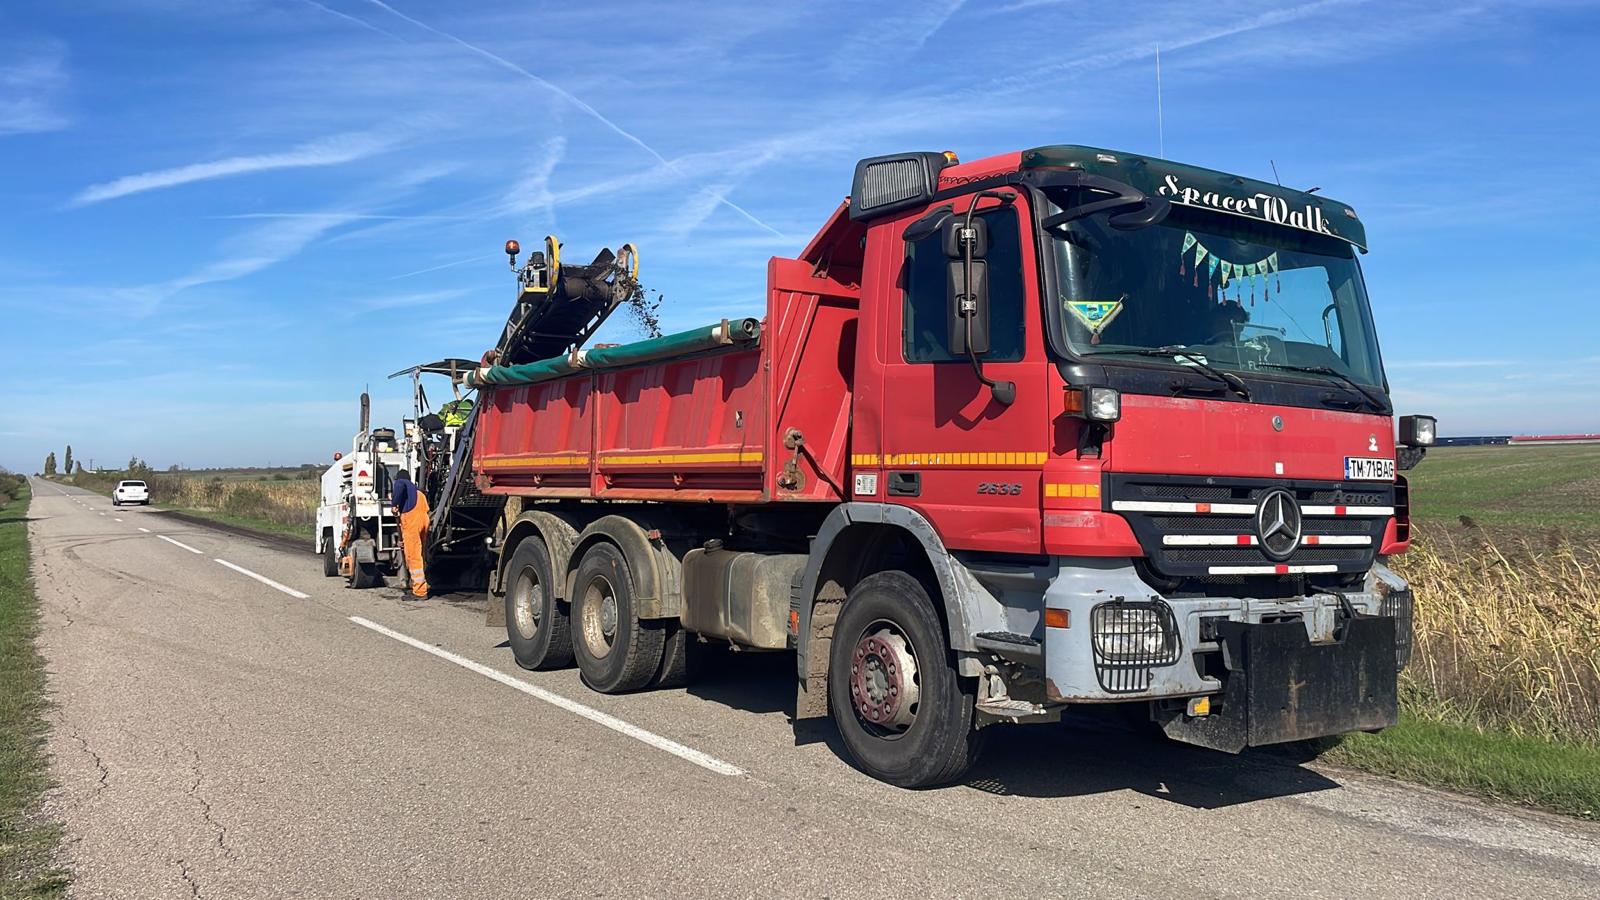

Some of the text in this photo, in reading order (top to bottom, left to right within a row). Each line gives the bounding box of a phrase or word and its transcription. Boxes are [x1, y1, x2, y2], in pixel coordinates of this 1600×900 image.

[1158, 174, 1332, 235] Space Walk
[1350, 460, 1364, 478] TM
[976, 481, 1023, 496] 2636
